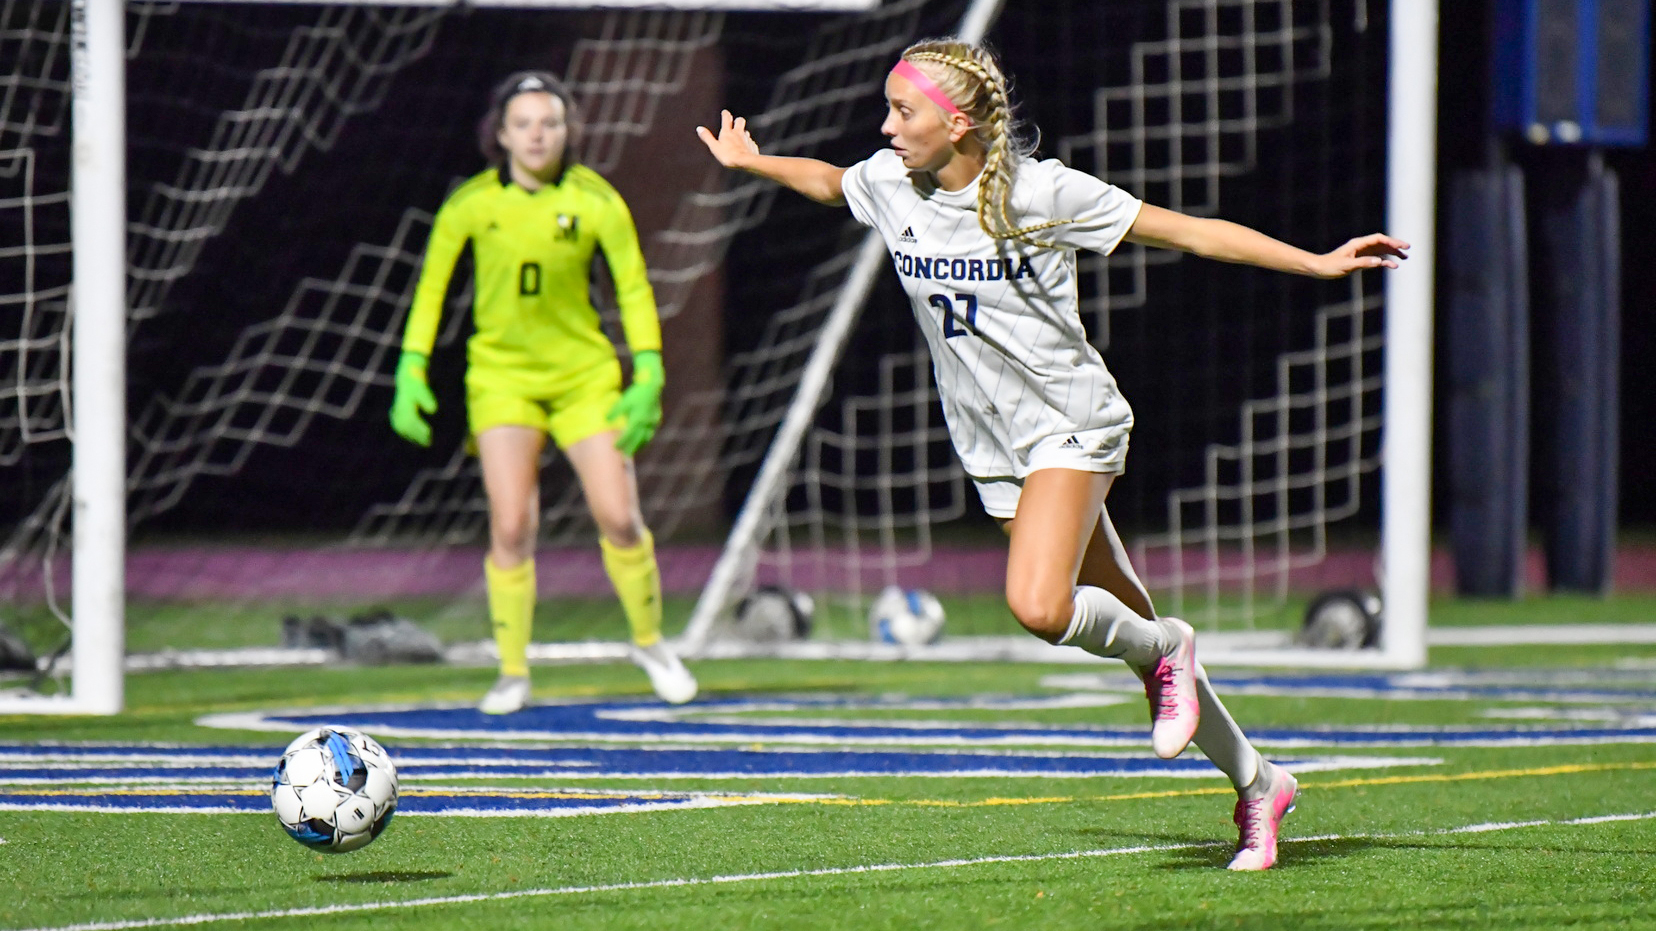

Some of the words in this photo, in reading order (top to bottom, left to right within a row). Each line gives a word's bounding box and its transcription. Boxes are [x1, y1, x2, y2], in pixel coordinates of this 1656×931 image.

[520, 261, 541, 296] 0
[894, 250, 1036, 282] CONCORDIA
[928, 292, 980, 339] 27
